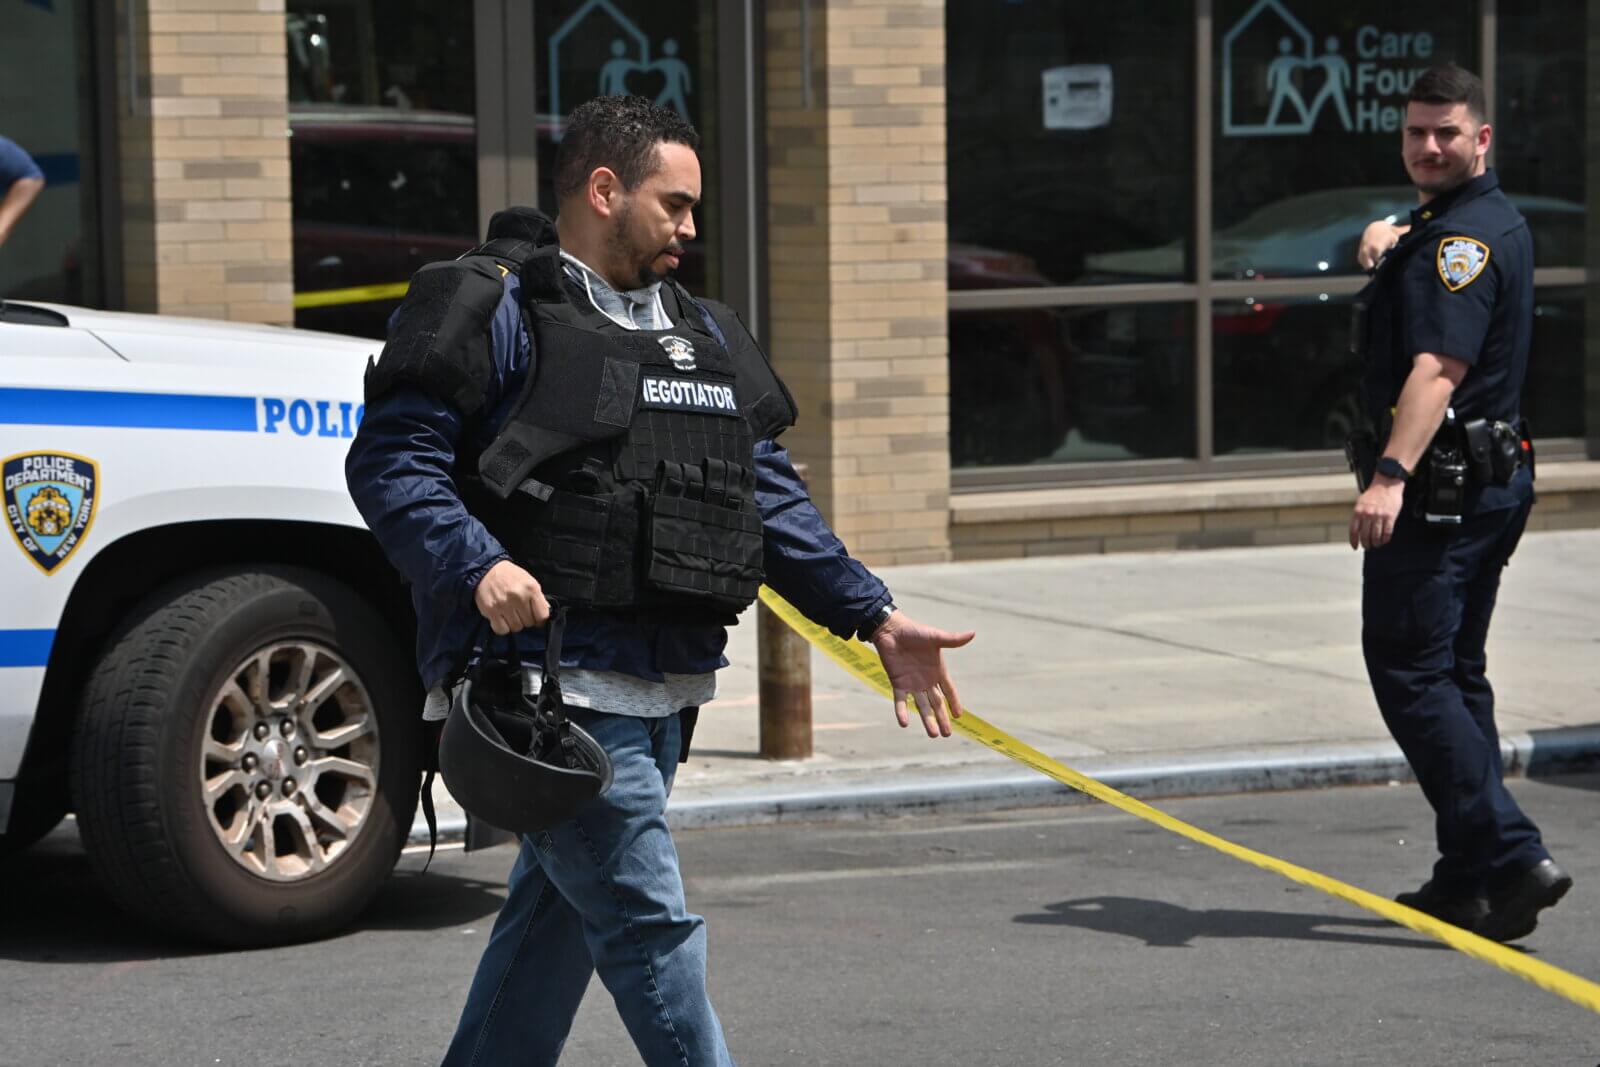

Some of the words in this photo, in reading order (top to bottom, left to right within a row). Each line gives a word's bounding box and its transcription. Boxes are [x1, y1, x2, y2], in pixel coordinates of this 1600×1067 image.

[1356, 25, 1433, 58] Care
[1356, 62, 1425, 95] Fou
[5, 469, 92, 490] DEPARTMENT
[23, 456, 75, 472] POLICE
[7, 504, 26, 533] CITY
[22, 537, 39, 552] OF
[56, 532, 78, 559] NEW
[75, 498, 93, 529] YORK
